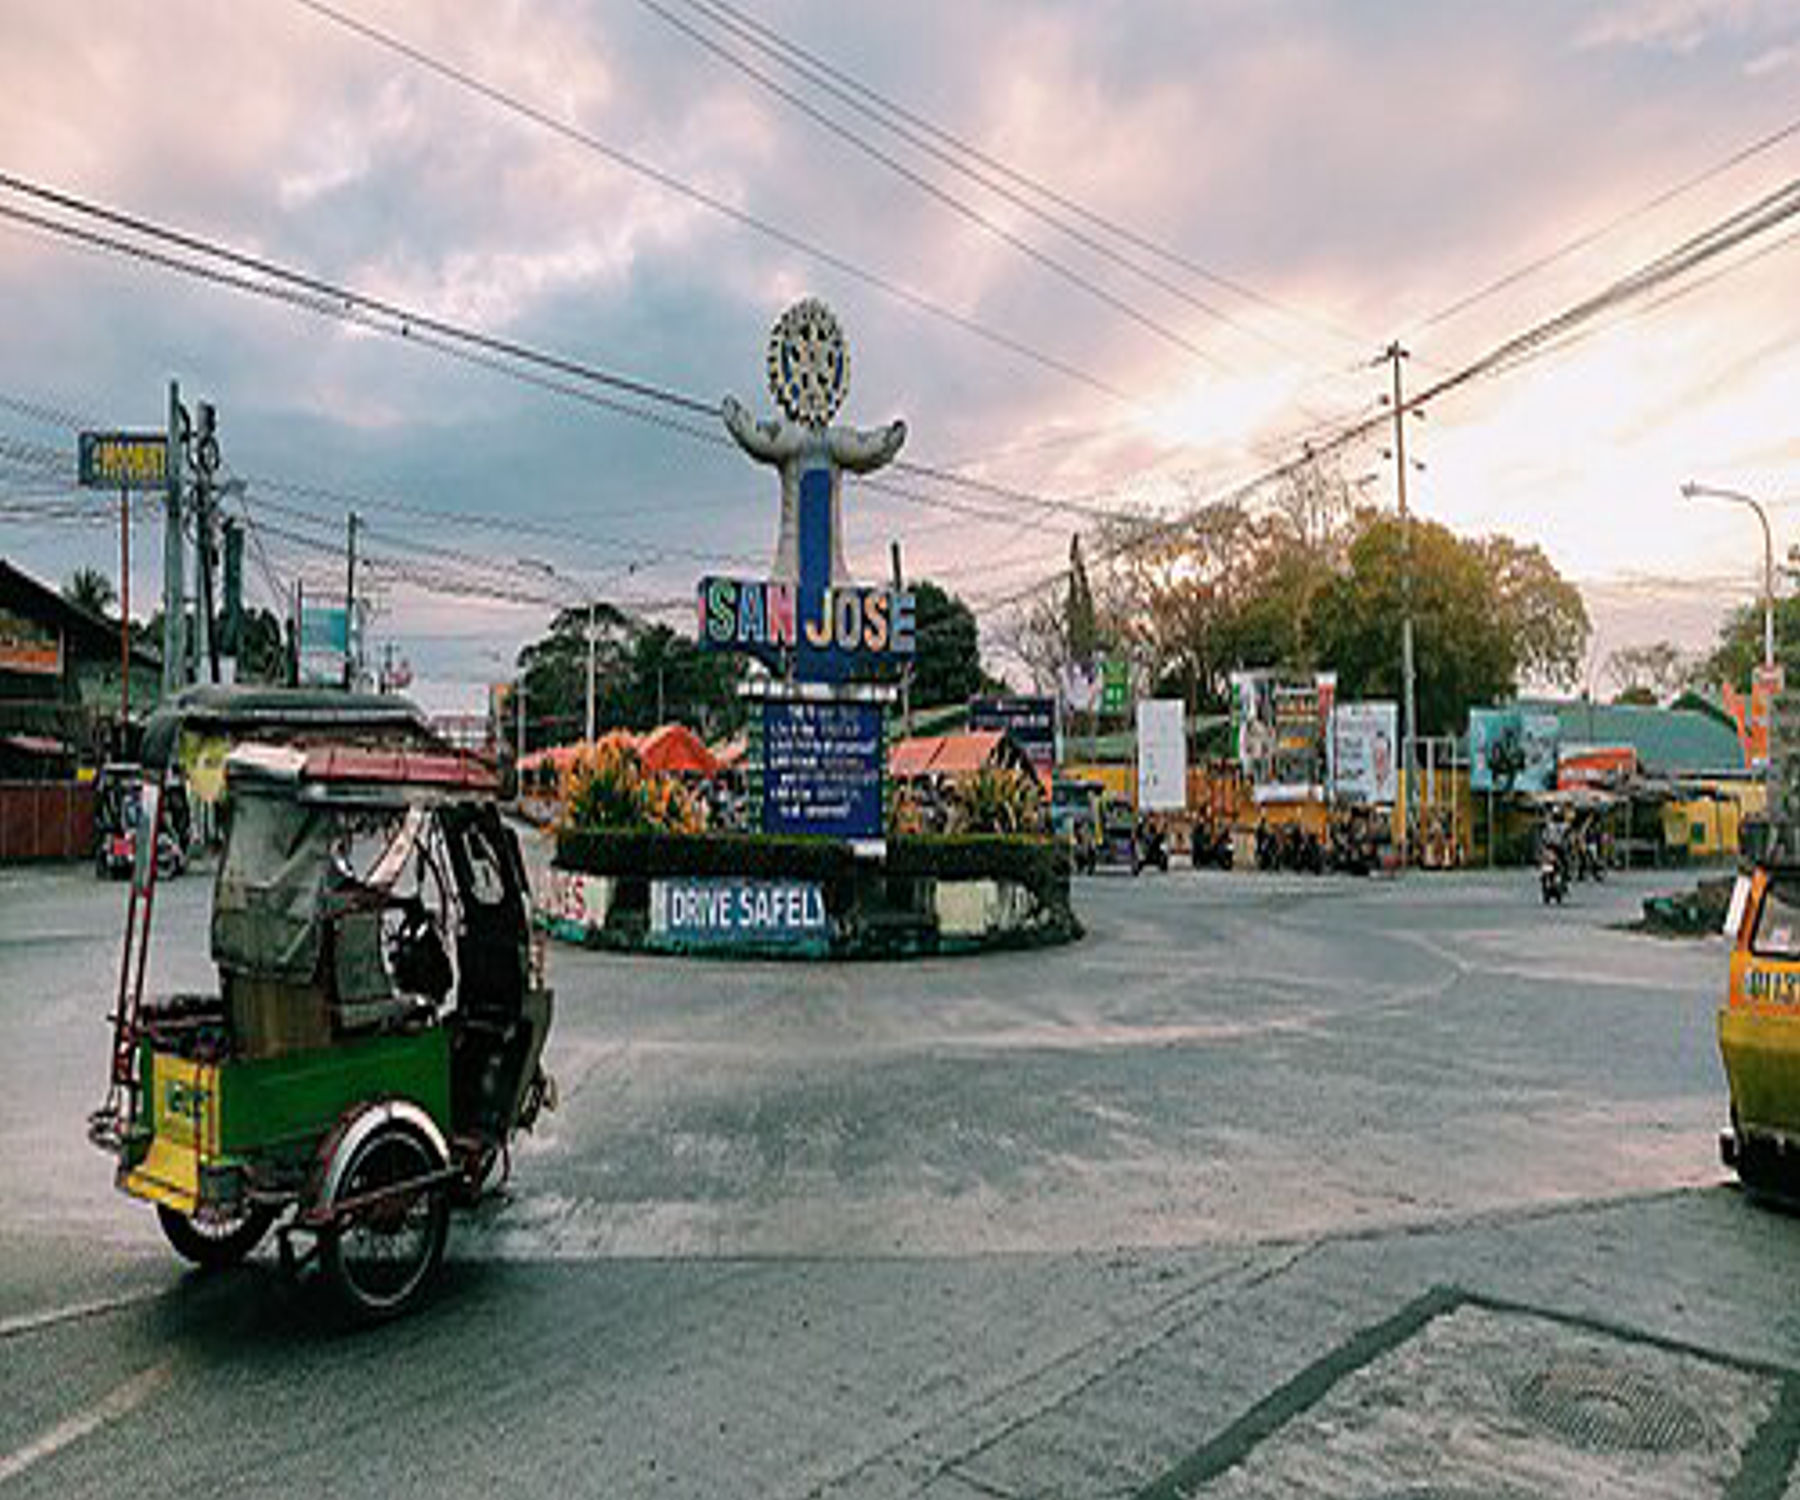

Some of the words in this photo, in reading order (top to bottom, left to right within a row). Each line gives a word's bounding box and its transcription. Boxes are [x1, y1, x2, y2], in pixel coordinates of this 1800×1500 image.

[709, 580, 796, 644] SAN
[806, 588, 915, 651] JOSE
[672, 888, 732, 926] DRIVE
